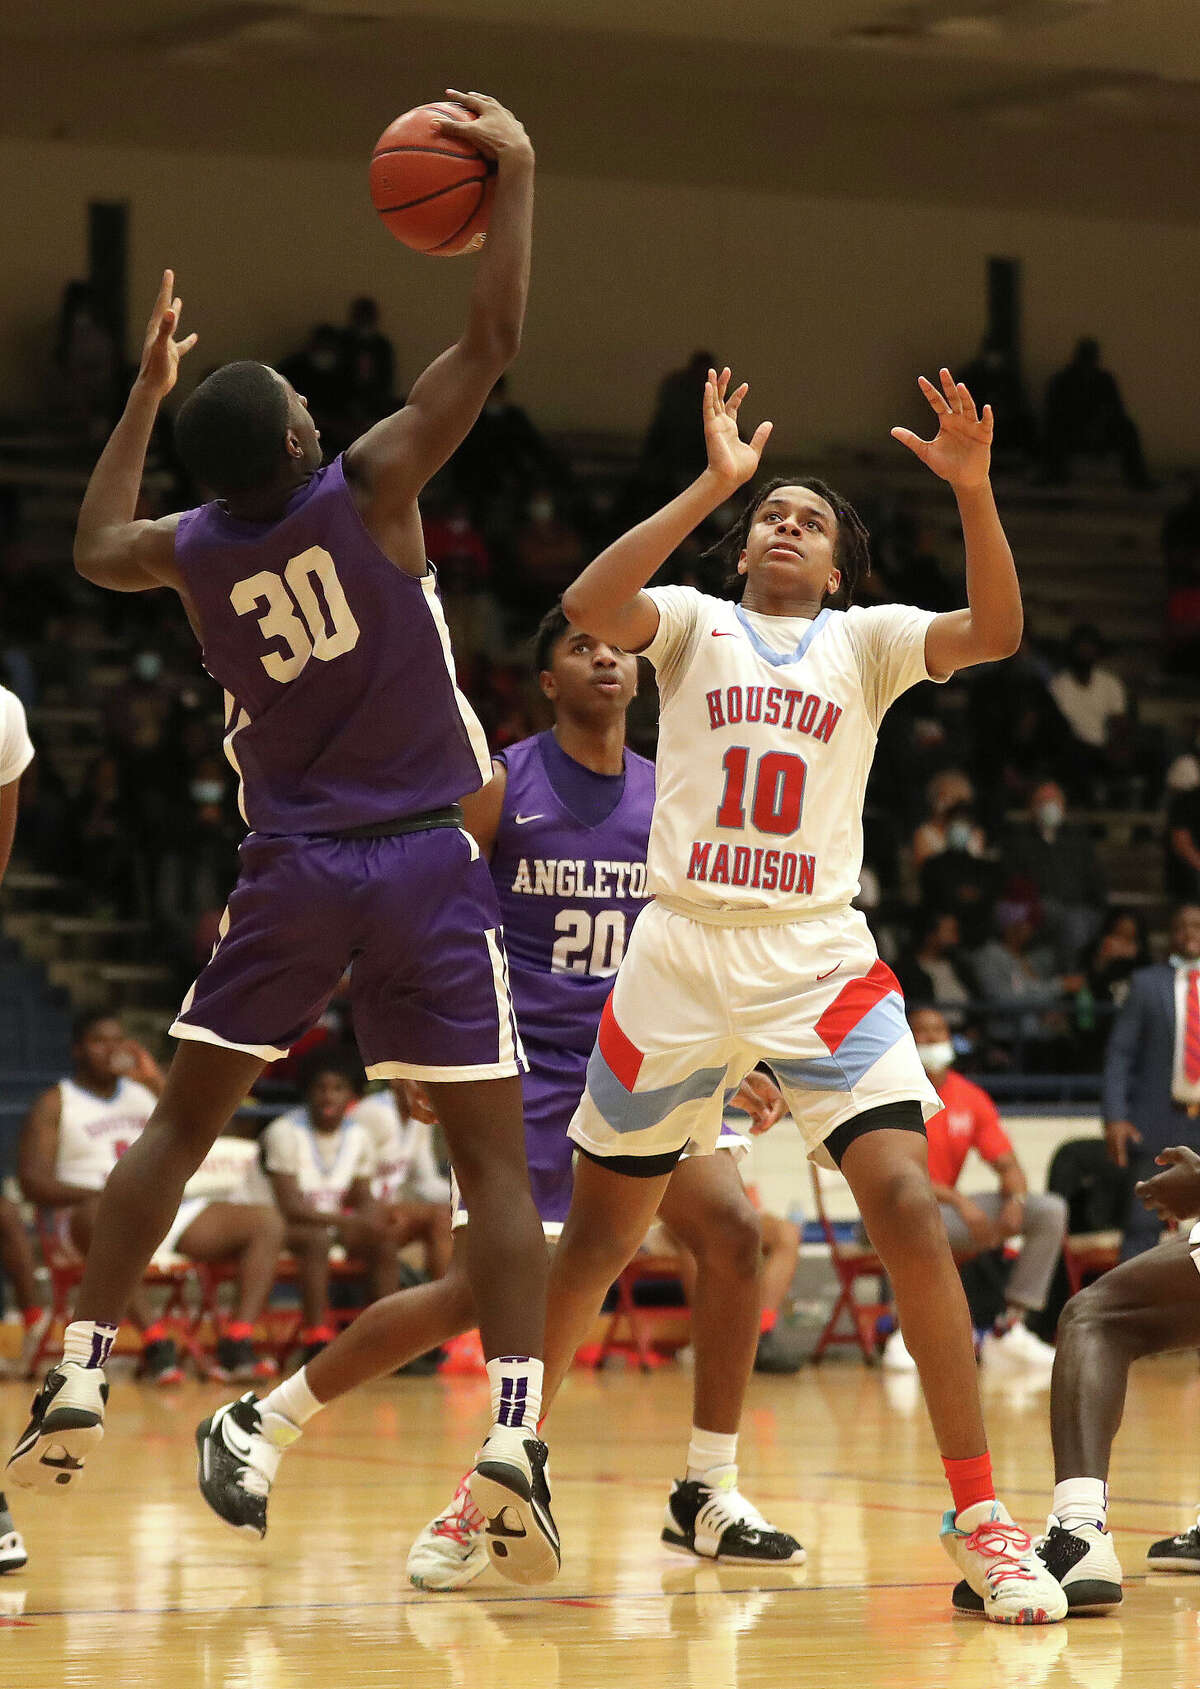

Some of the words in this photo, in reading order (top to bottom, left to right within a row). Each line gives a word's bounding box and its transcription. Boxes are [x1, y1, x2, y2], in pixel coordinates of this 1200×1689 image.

[229, 544, 361, 684] 30
[705, 685, 843, 744] HOUSTON
[716, 745, 808, 837] 10
[511, 858, 649, 899] ANGLETO
[686, 841, 816, 896] MADISON
[550, 909, 626, 978] 20
